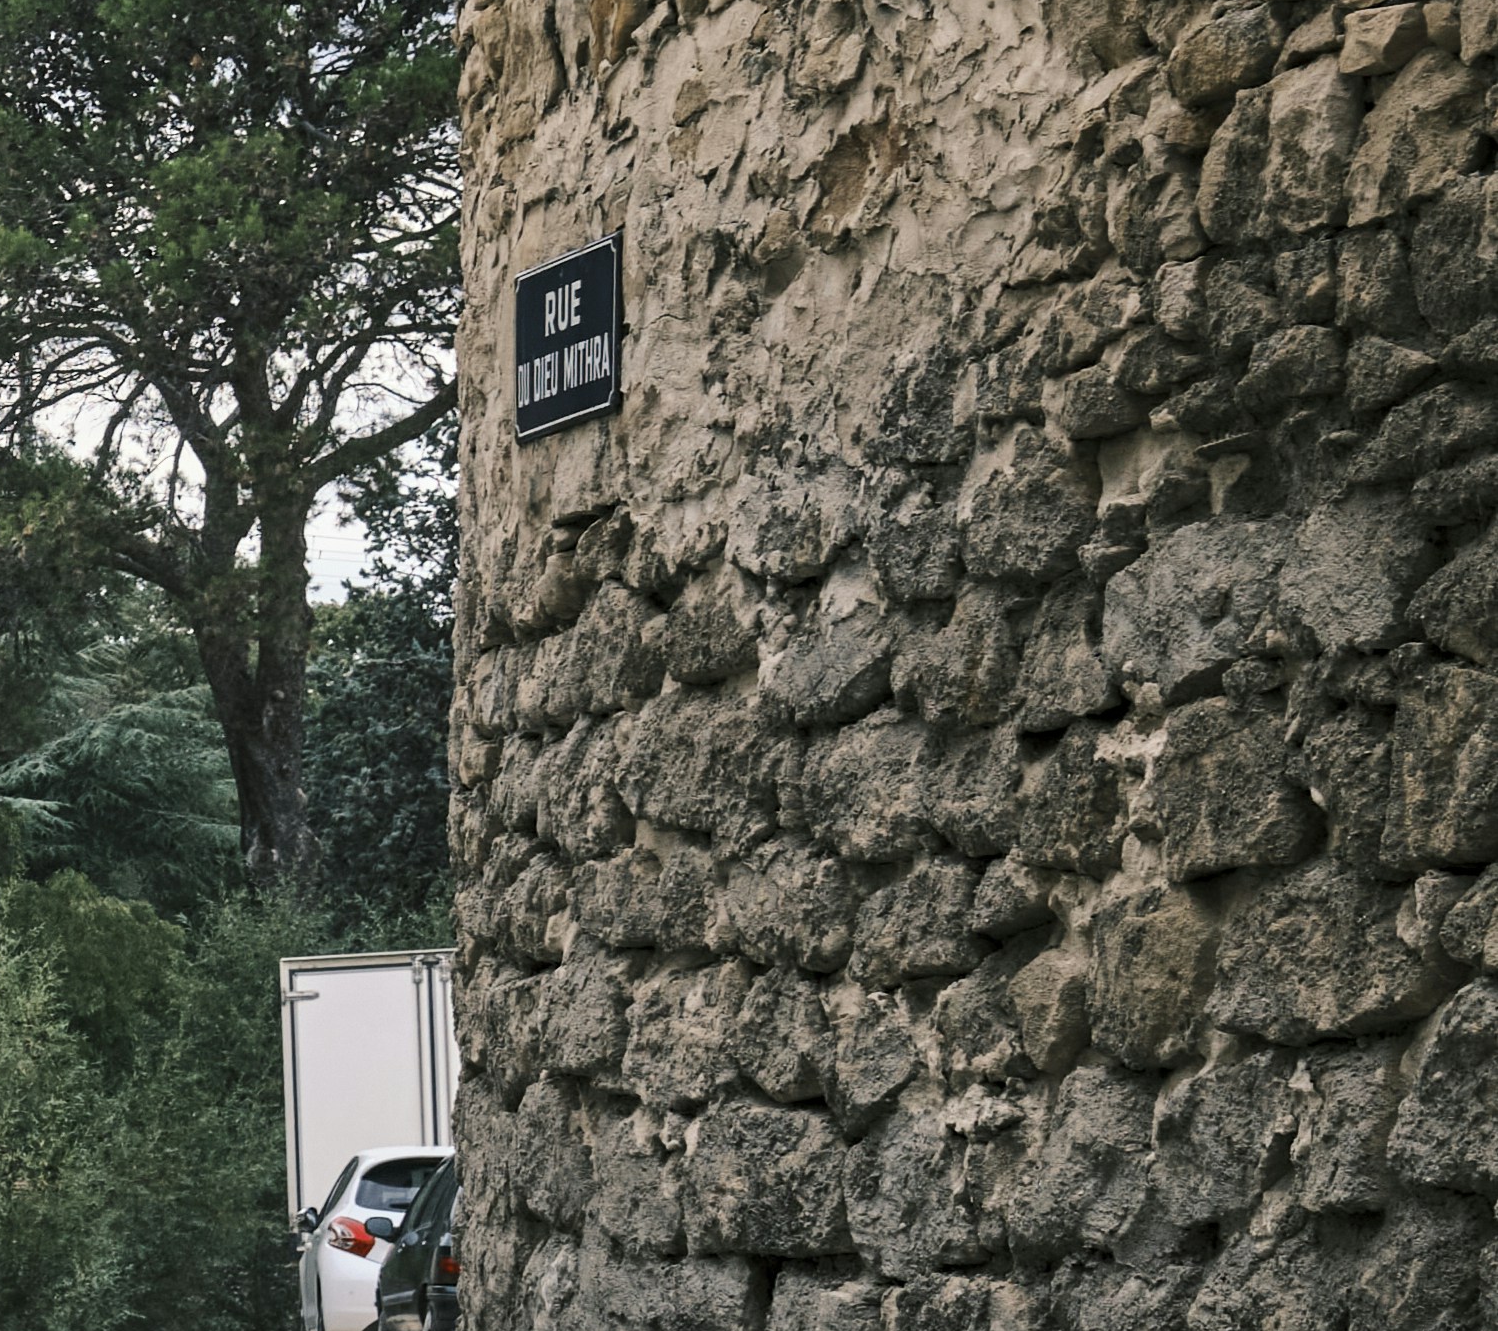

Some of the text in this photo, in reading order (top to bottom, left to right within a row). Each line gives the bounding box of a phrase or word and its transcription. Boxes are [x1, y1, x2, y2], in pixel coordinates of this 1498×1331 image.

[544, 279, 582, 338] RUE
[517, 331, 610, 409] DU DIEU MITHRA
